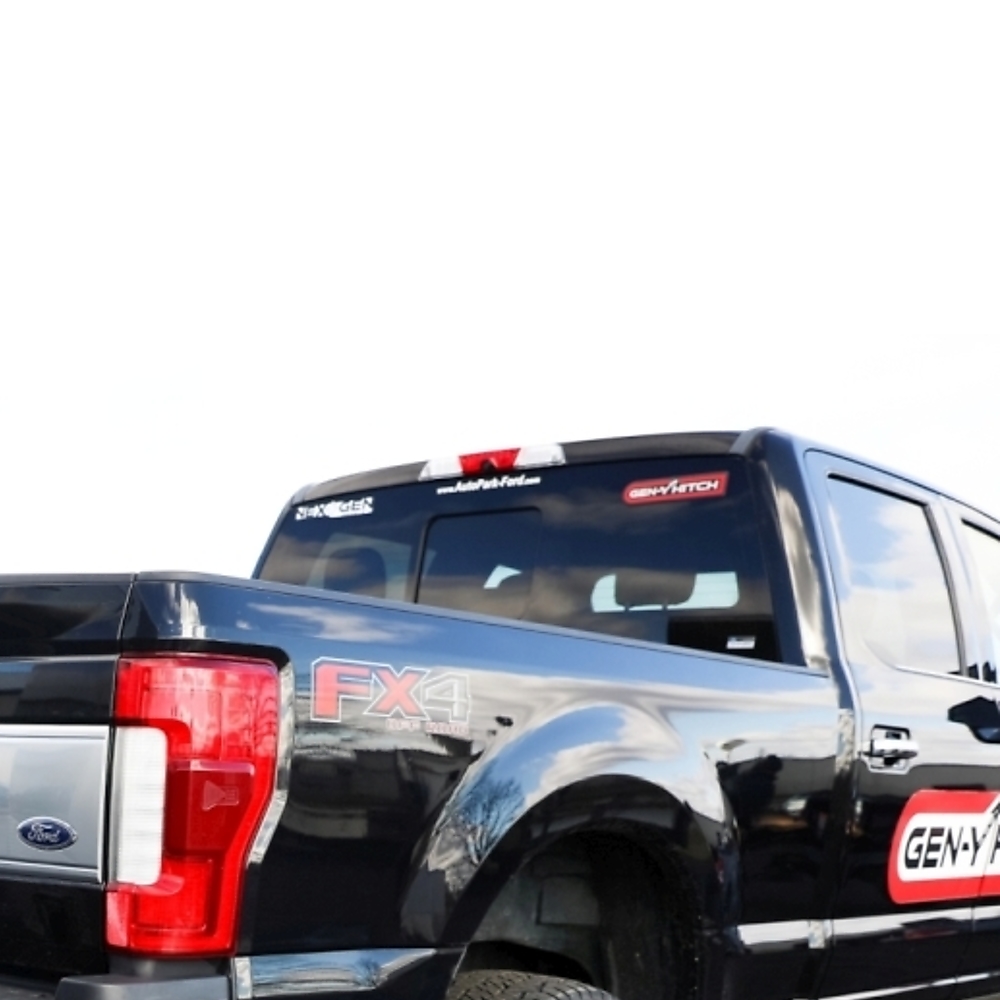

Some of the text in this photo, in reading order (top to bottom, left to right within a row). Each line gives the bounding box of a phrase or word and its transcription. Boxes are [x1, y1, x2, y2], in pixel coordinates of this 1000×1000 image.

[671, 480, 719, 494] HITCH
[310, 656, 471, 723] FX4
[904, 825, 985, 869] GEN-Y
